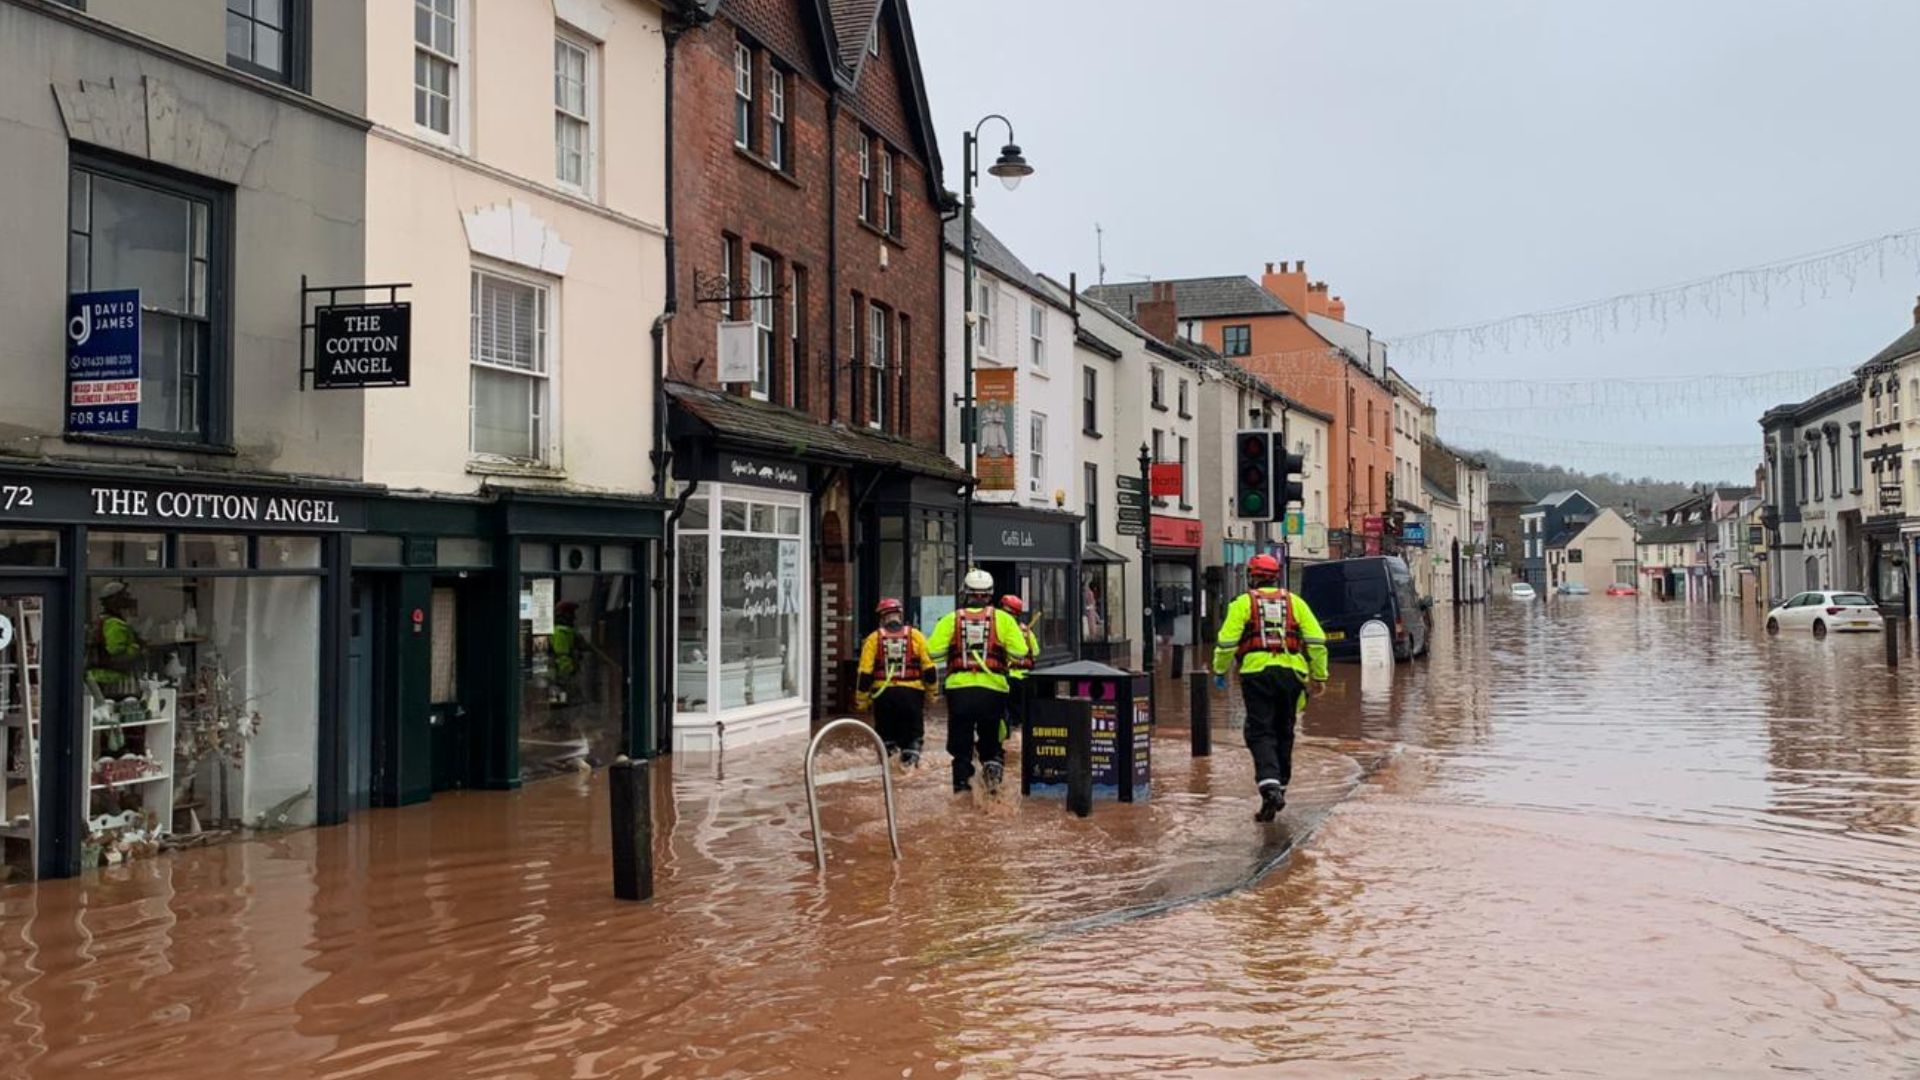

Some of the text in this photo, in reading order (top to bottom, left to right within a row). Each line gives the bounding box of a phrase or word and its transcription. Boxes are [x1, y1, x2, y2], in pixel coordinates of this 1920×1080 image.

[95, 301, 135, 316] DAVID
[95, 316, 135, 331] JAMES
[344, 315, 381, 332] THE
[326, 336, 399, 354] COTTON
[331, 357, 392, 375] ANGEL
[70, 409, 130, 425] FOR SALE
[2, 485, 33, 510] 72
[91, 487, 339, 523] THE COTTON ANGEL
[1036, 745, 1066, 756] LITTER
